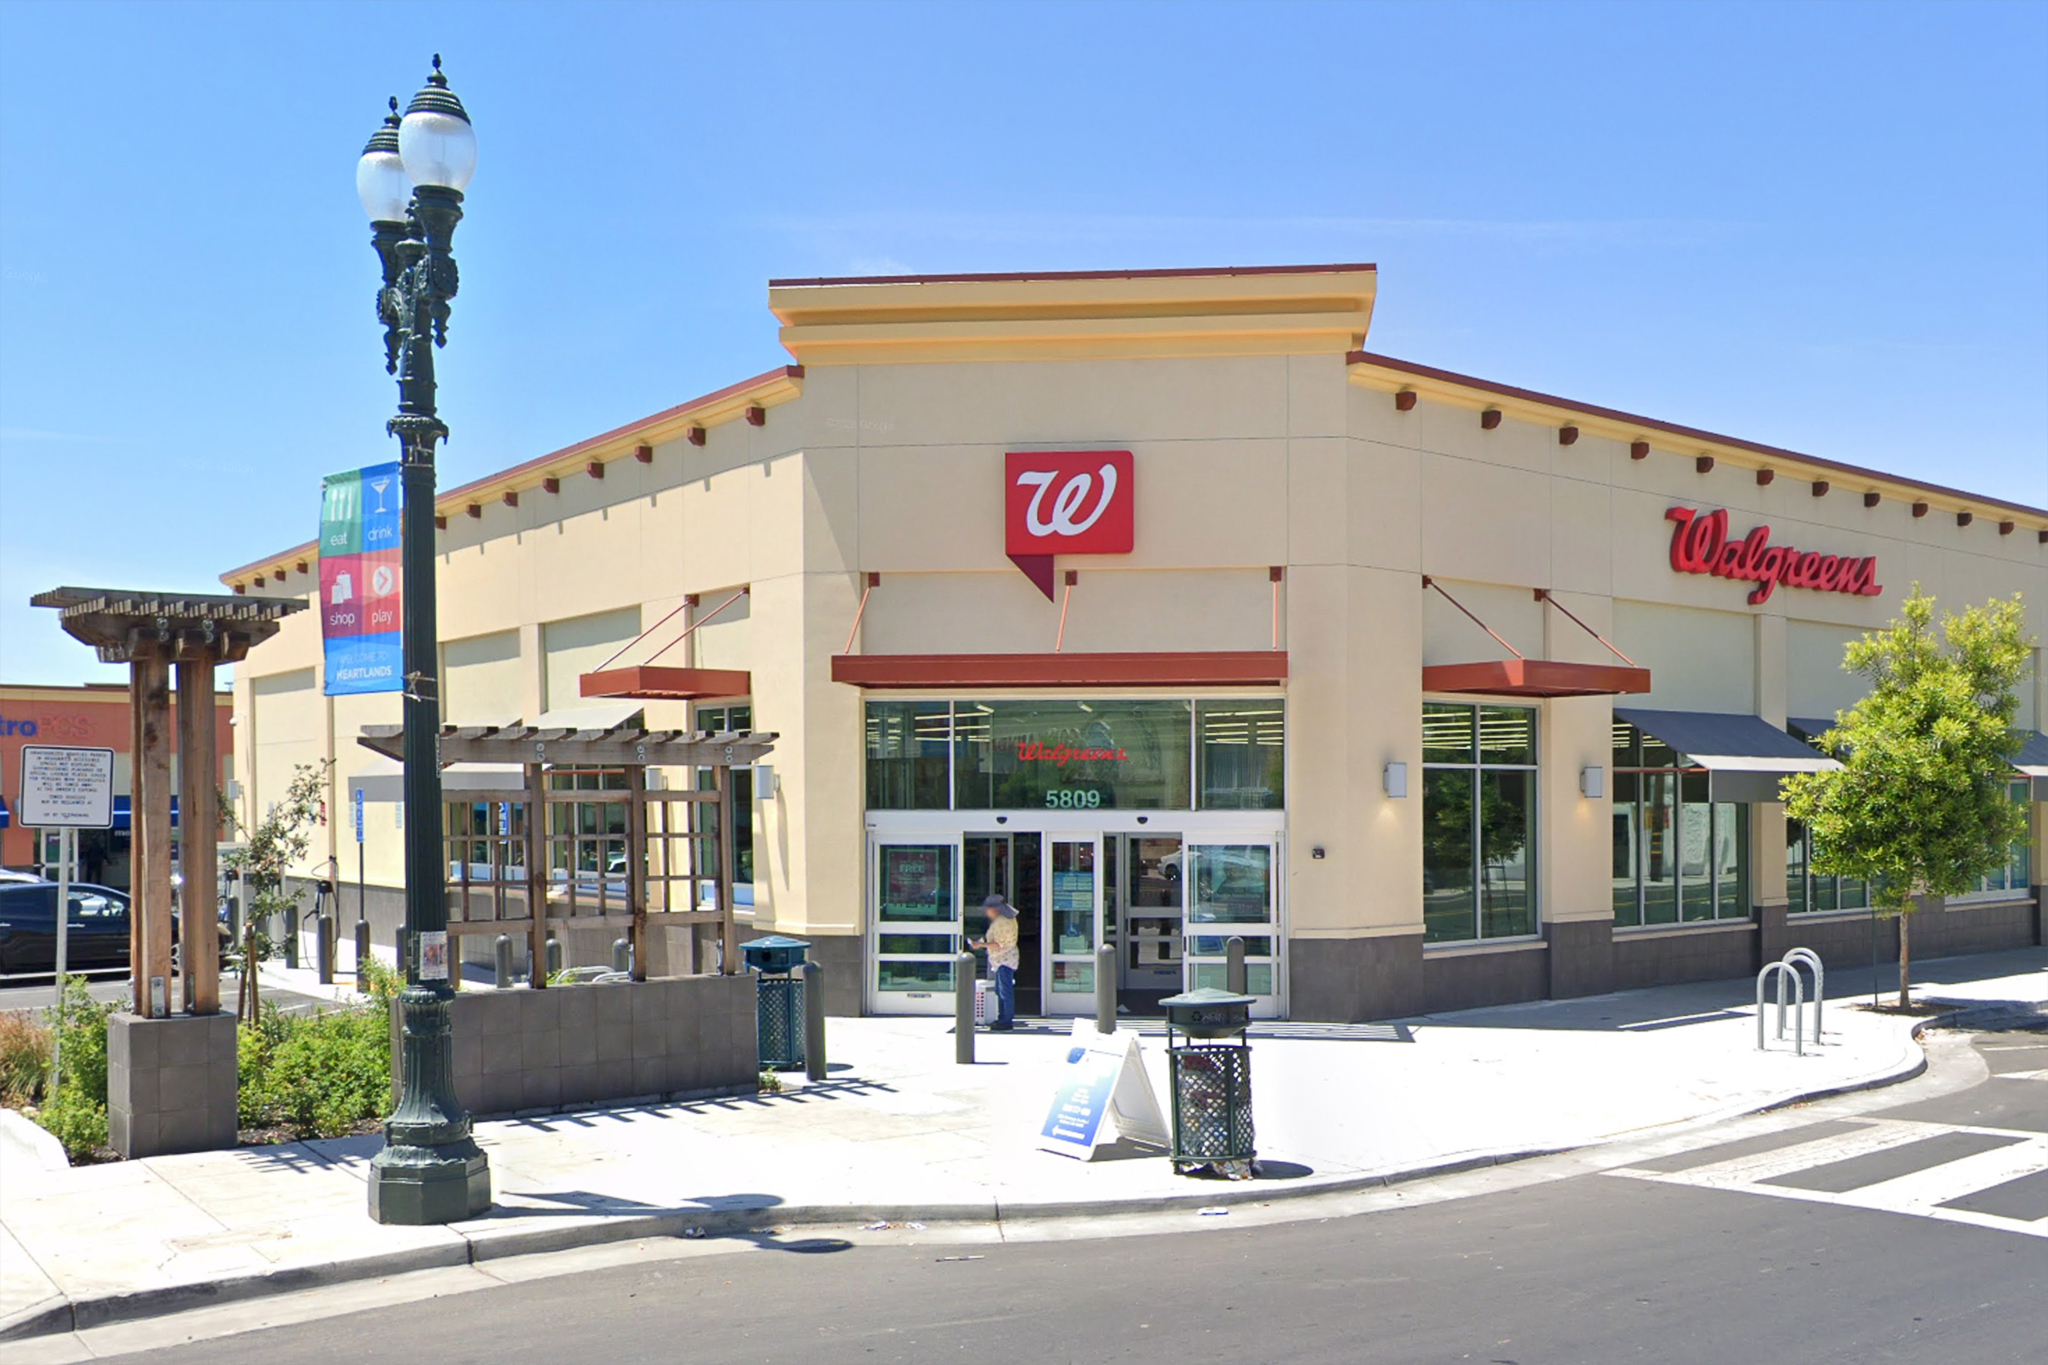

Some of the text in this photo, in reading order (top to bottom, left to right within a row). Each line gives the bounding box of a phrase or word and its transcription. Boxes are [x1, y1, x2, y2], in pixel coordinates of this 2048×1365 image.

[1016, 463, 1118, 537] W
[330, 532, 347, 546] eat
[367, 526, 393, 541] drink
[1665, 506, 1883, 605] Walgreens
[330, 612, 355, 628] shop
[371, 609, 393, 627] play
[340, 652, 376, 665] WELCOME
[336, 665, 393, 681] HEARTLANDS
[1017, 741, 1128, 767] Walgreens
[1045, 790, 1100, 809] 5809
